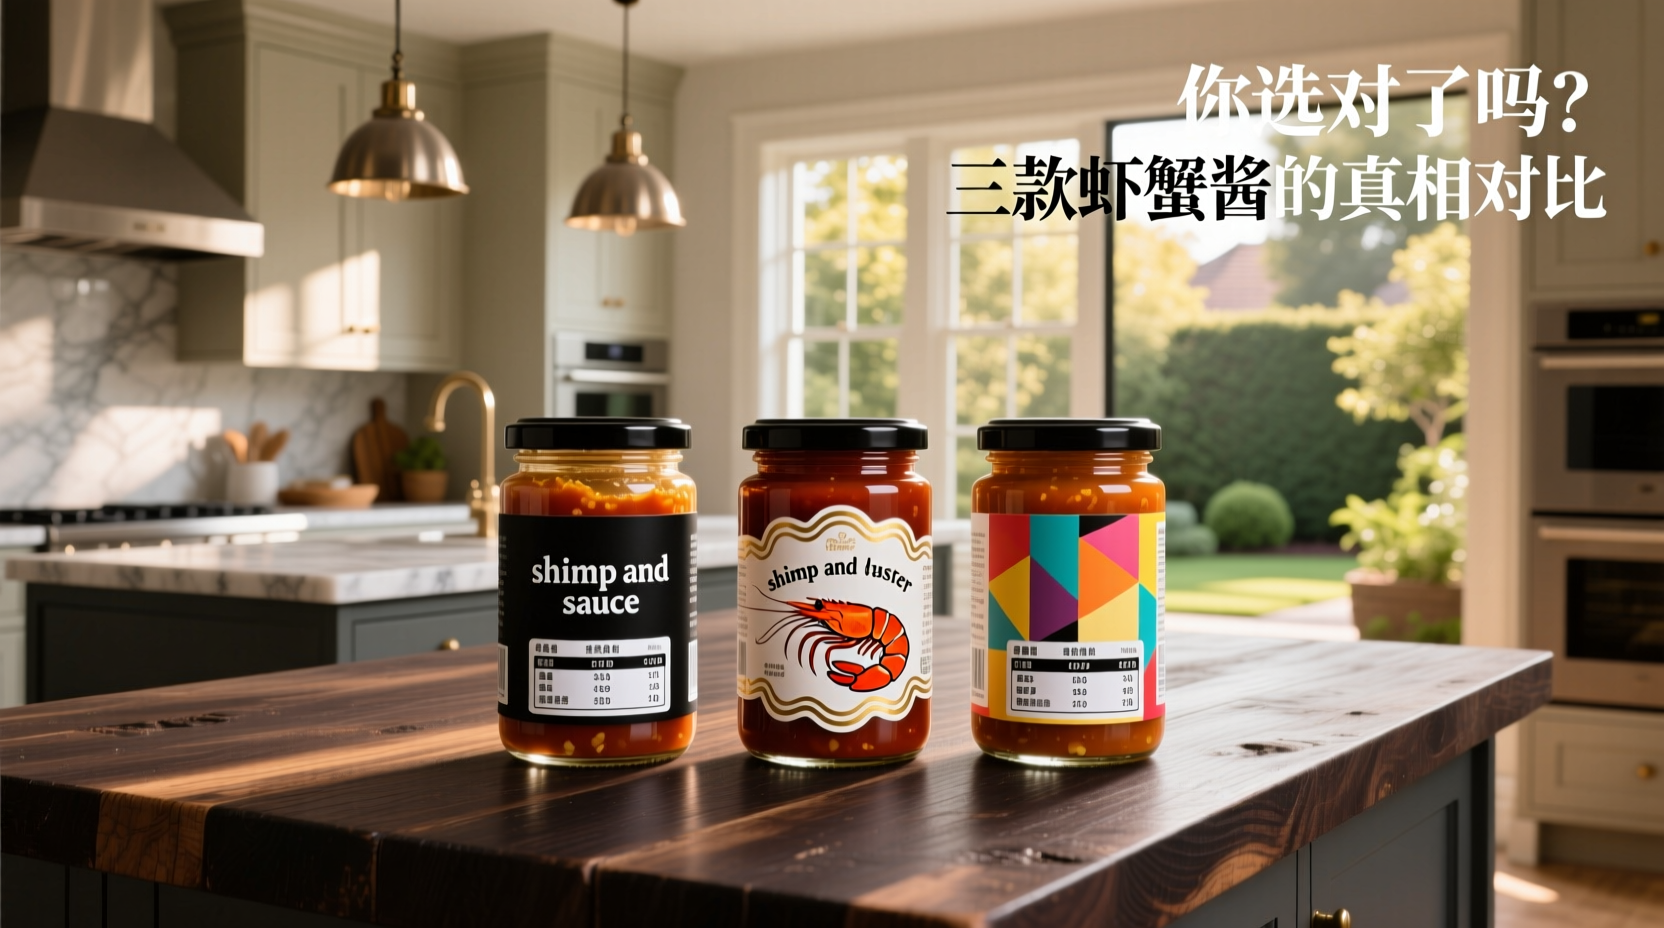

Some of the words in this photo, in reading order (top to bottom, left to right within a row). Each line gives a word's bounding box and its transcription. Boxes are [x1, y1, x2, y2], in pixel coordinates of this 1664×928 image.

[532, 554, 617, 591] shimp
[623, 553, 669, 583] and
[767, 564, 819, 592] shimp
[824, 556, 857, 576] and
[562, 594, 640, 615] sauce
